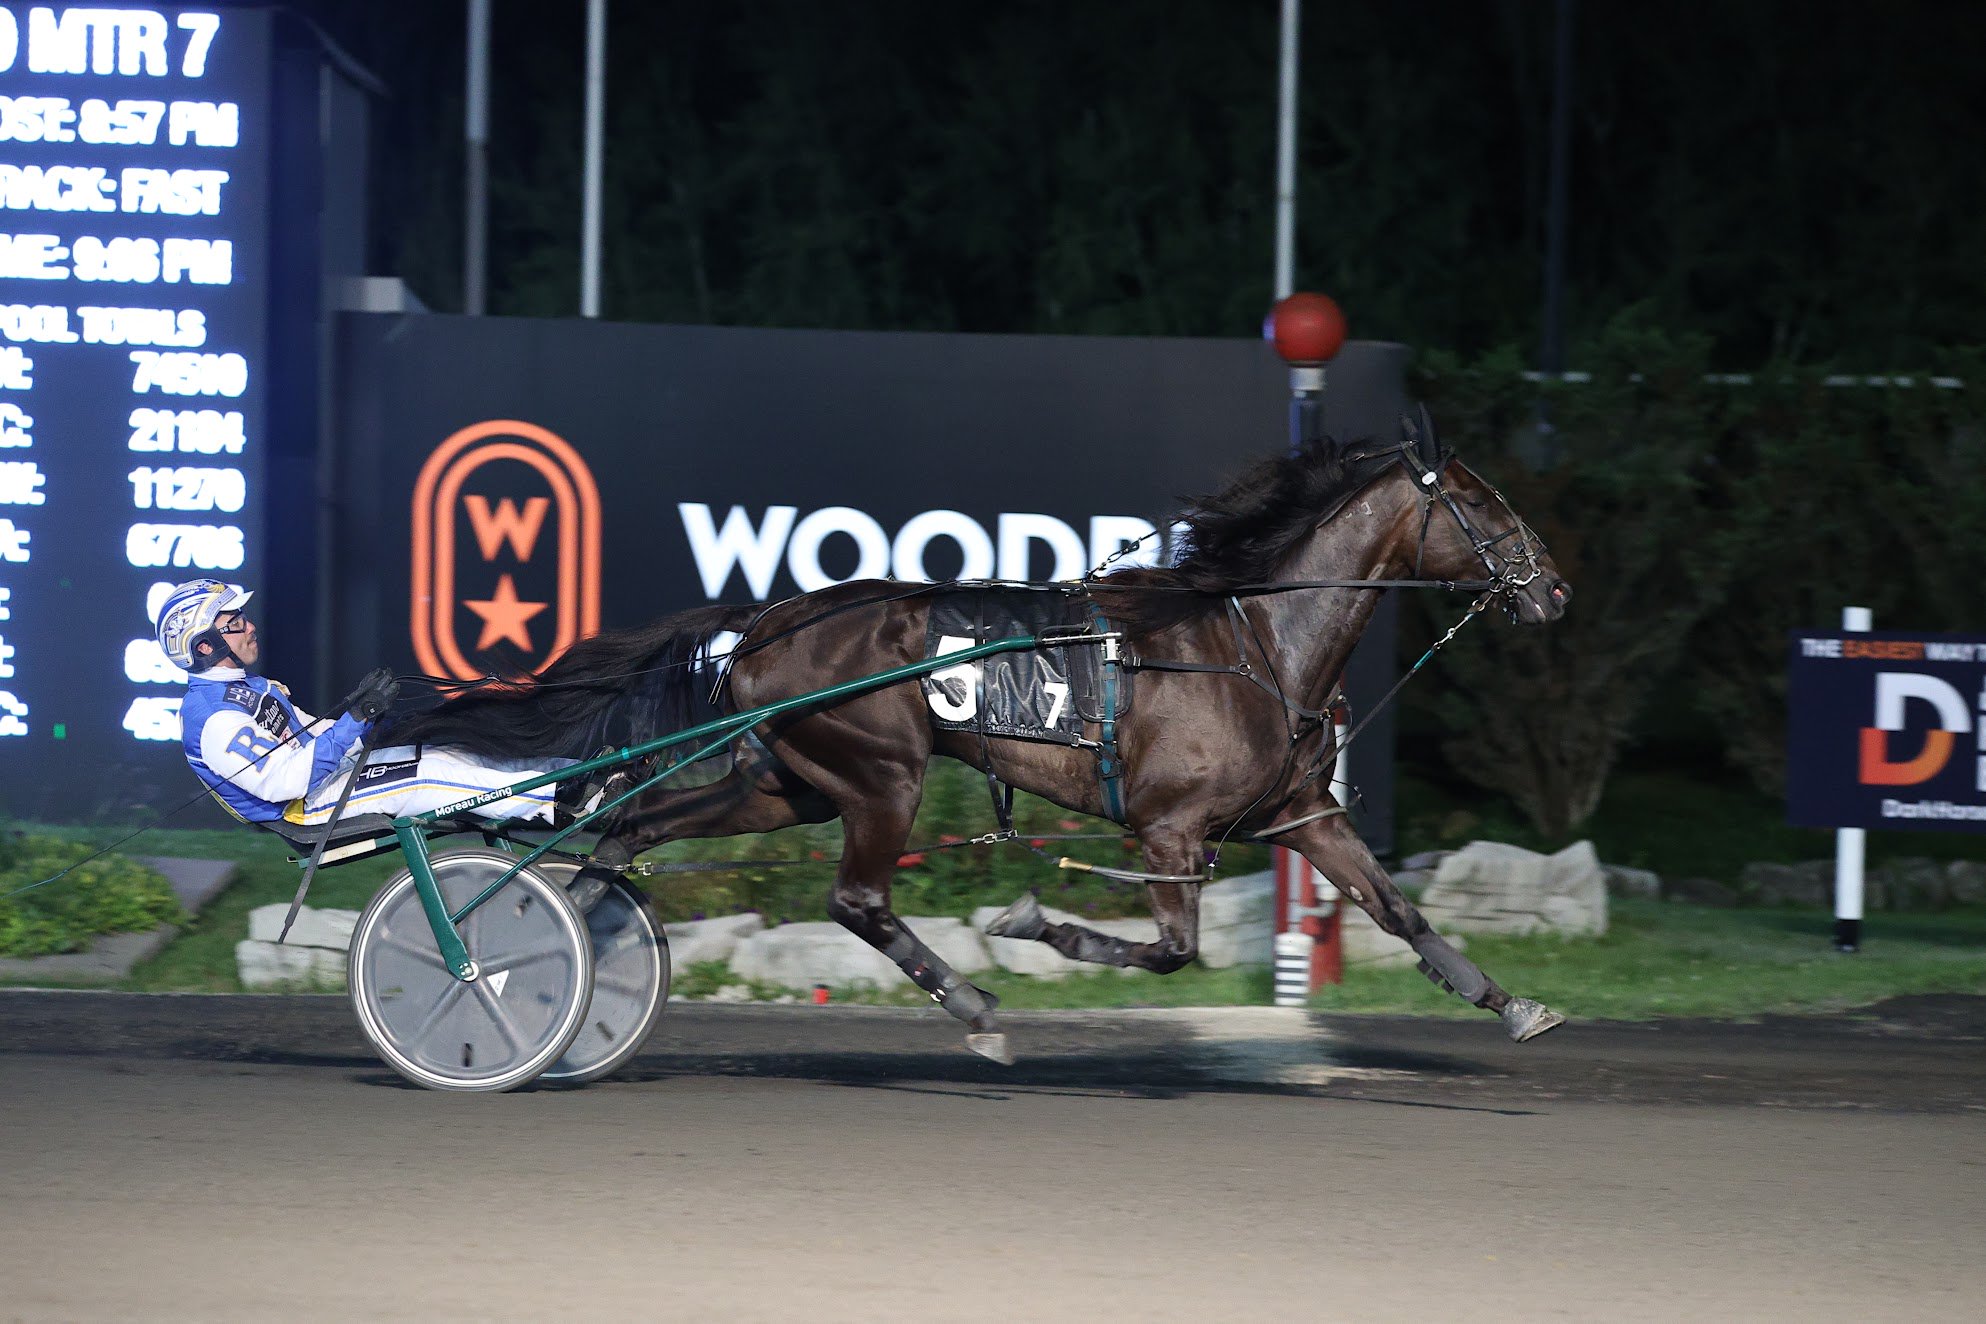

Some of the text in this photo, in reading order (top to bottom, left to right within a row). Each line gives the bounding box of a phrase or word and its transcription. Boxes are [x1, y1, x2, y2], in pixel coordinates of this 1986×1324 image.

[28, 7, 168, 76] MTR
[177, 13, 220, 78] 7
[169, 101, 239, 147] PM
[121, 168, 230, 215] FAST
[163, 238, 232, 285] PM
[77, 306, 206, 347] TOTALS
[463, 495, 551, 562] W
[927, 635, 985, 722] 5
[1043, 681, 1069, 729] 7
[225, 726, 279, 774] R
[434, 786, 513, 818] Moreau Racing
